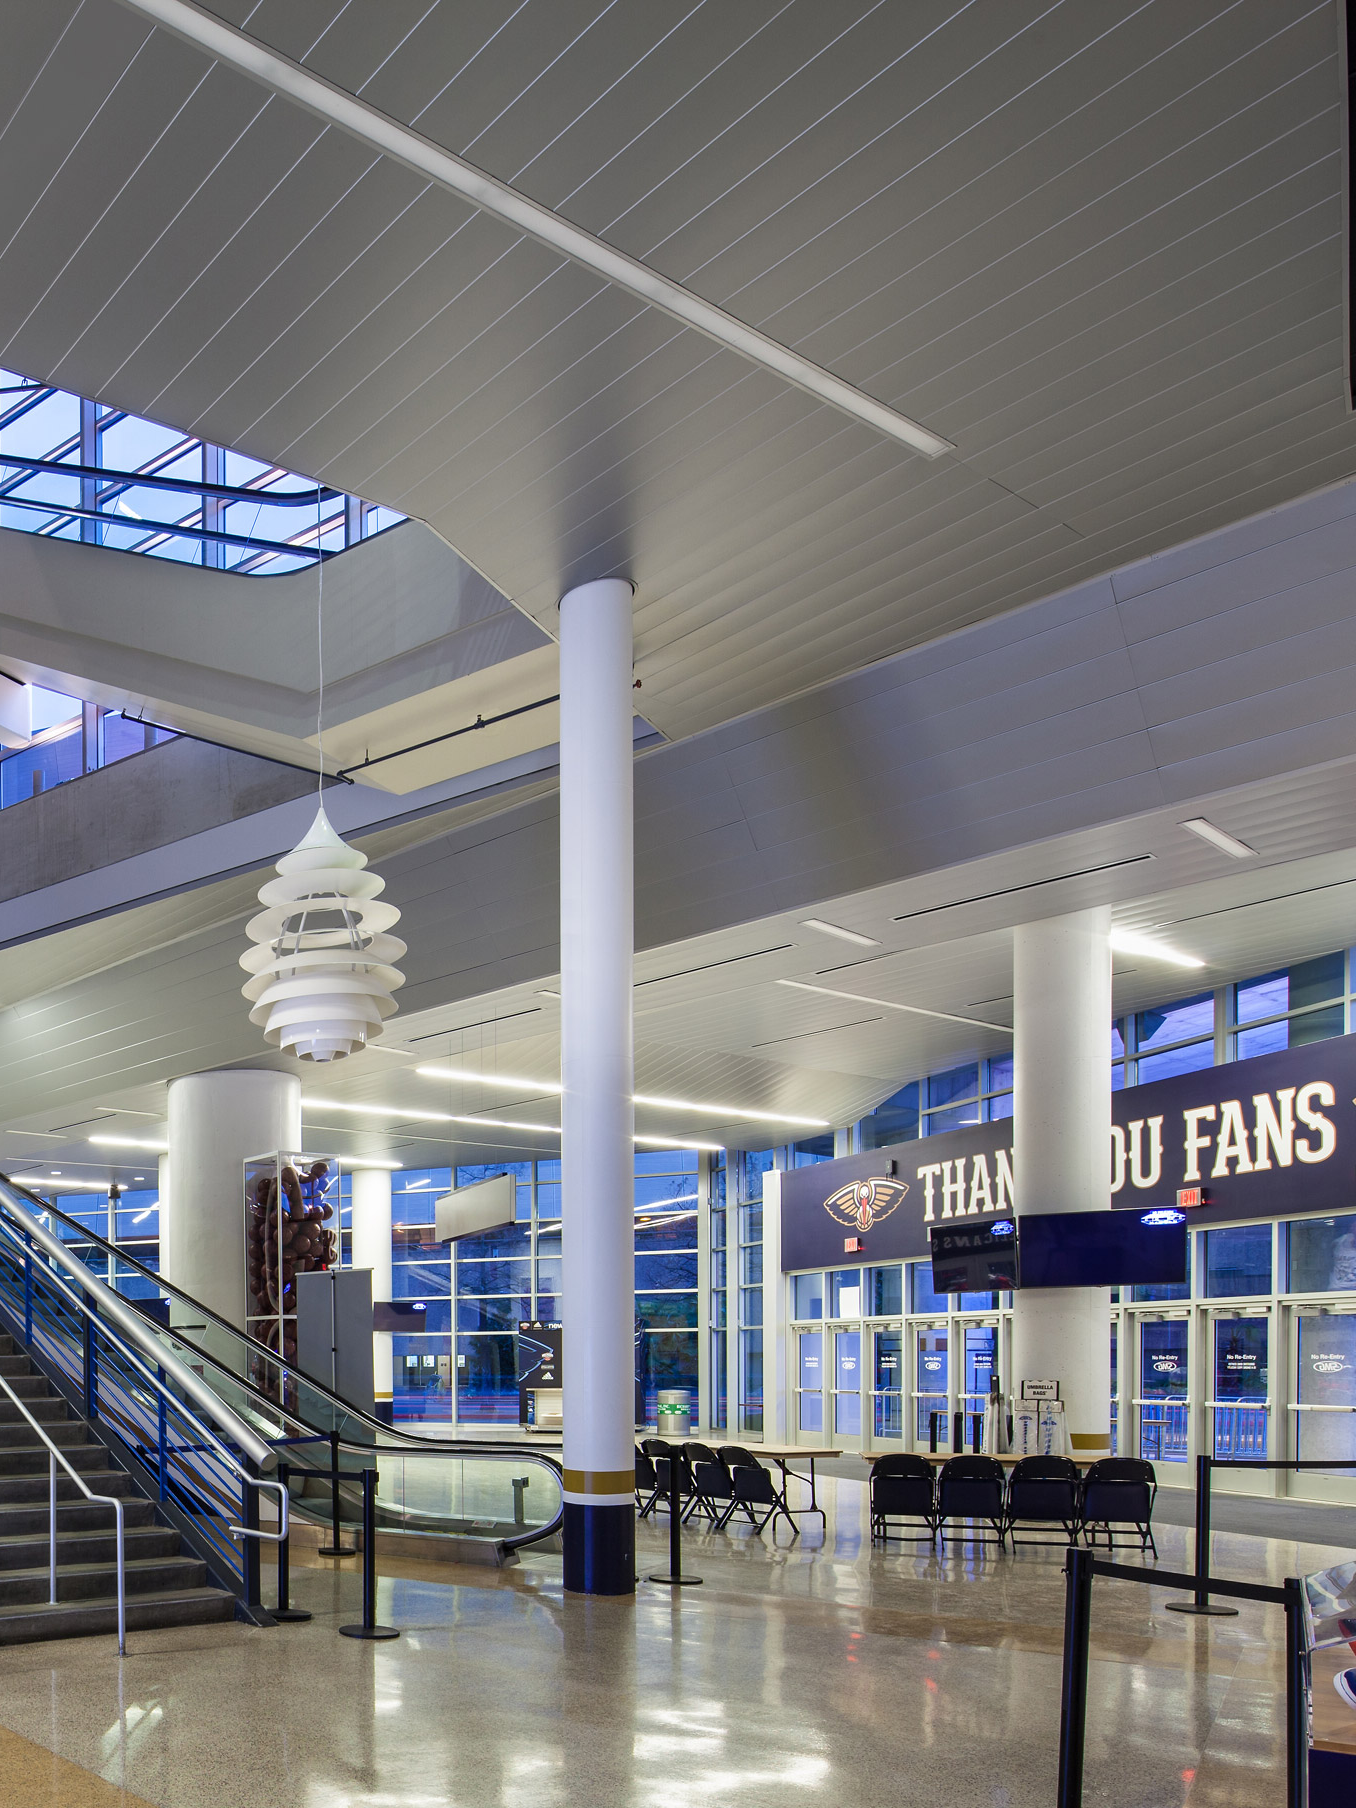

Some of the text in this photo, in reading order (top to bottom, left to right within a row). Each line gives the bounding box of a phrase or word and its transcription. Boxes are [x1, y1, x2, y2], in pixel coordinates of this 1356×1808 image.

[917, 1147, 1014, 1222] THAN
[1183, 1080, 1337, 1182] FANS
[1181, 1189, 1198, 1206] EXIT
